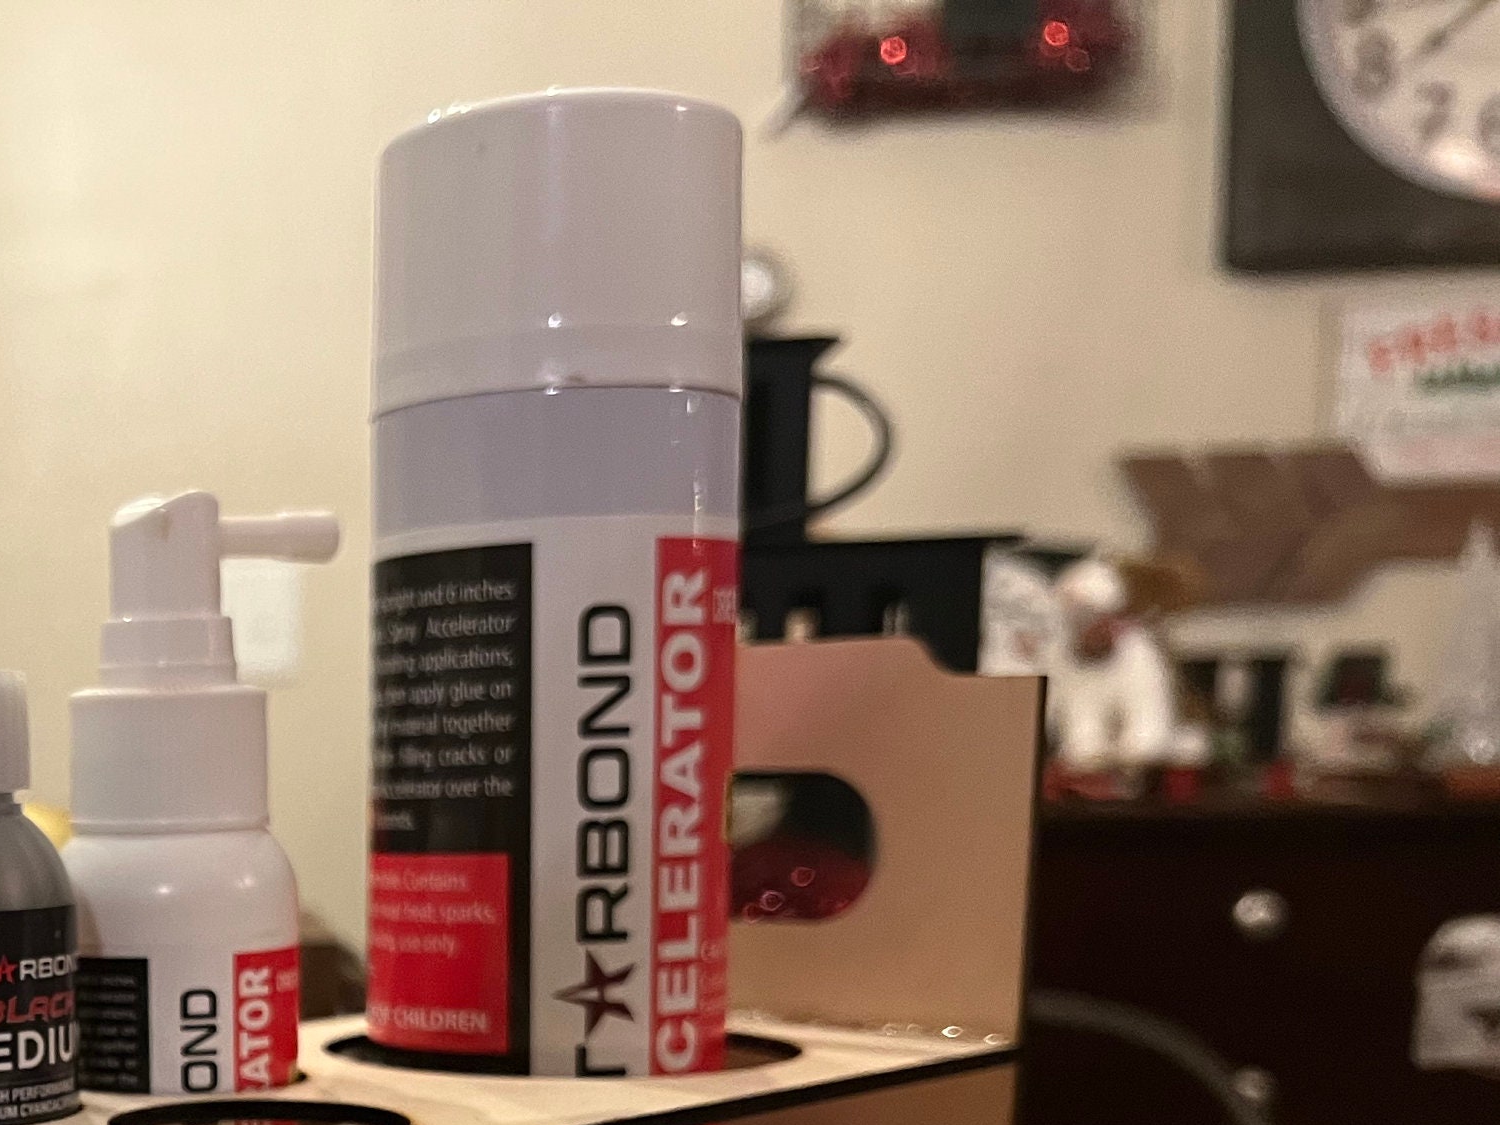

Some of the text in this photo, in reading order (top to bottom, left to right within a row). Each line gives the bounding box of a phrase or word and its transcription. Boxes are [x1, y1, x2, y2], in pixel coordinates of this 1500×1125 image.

[425, 613, 514, 639] Accelerator
[489, 682, 512, 702] on
[442, 709, 513, 739] together
[394, 1006, 489, 1034] CHILDREN
